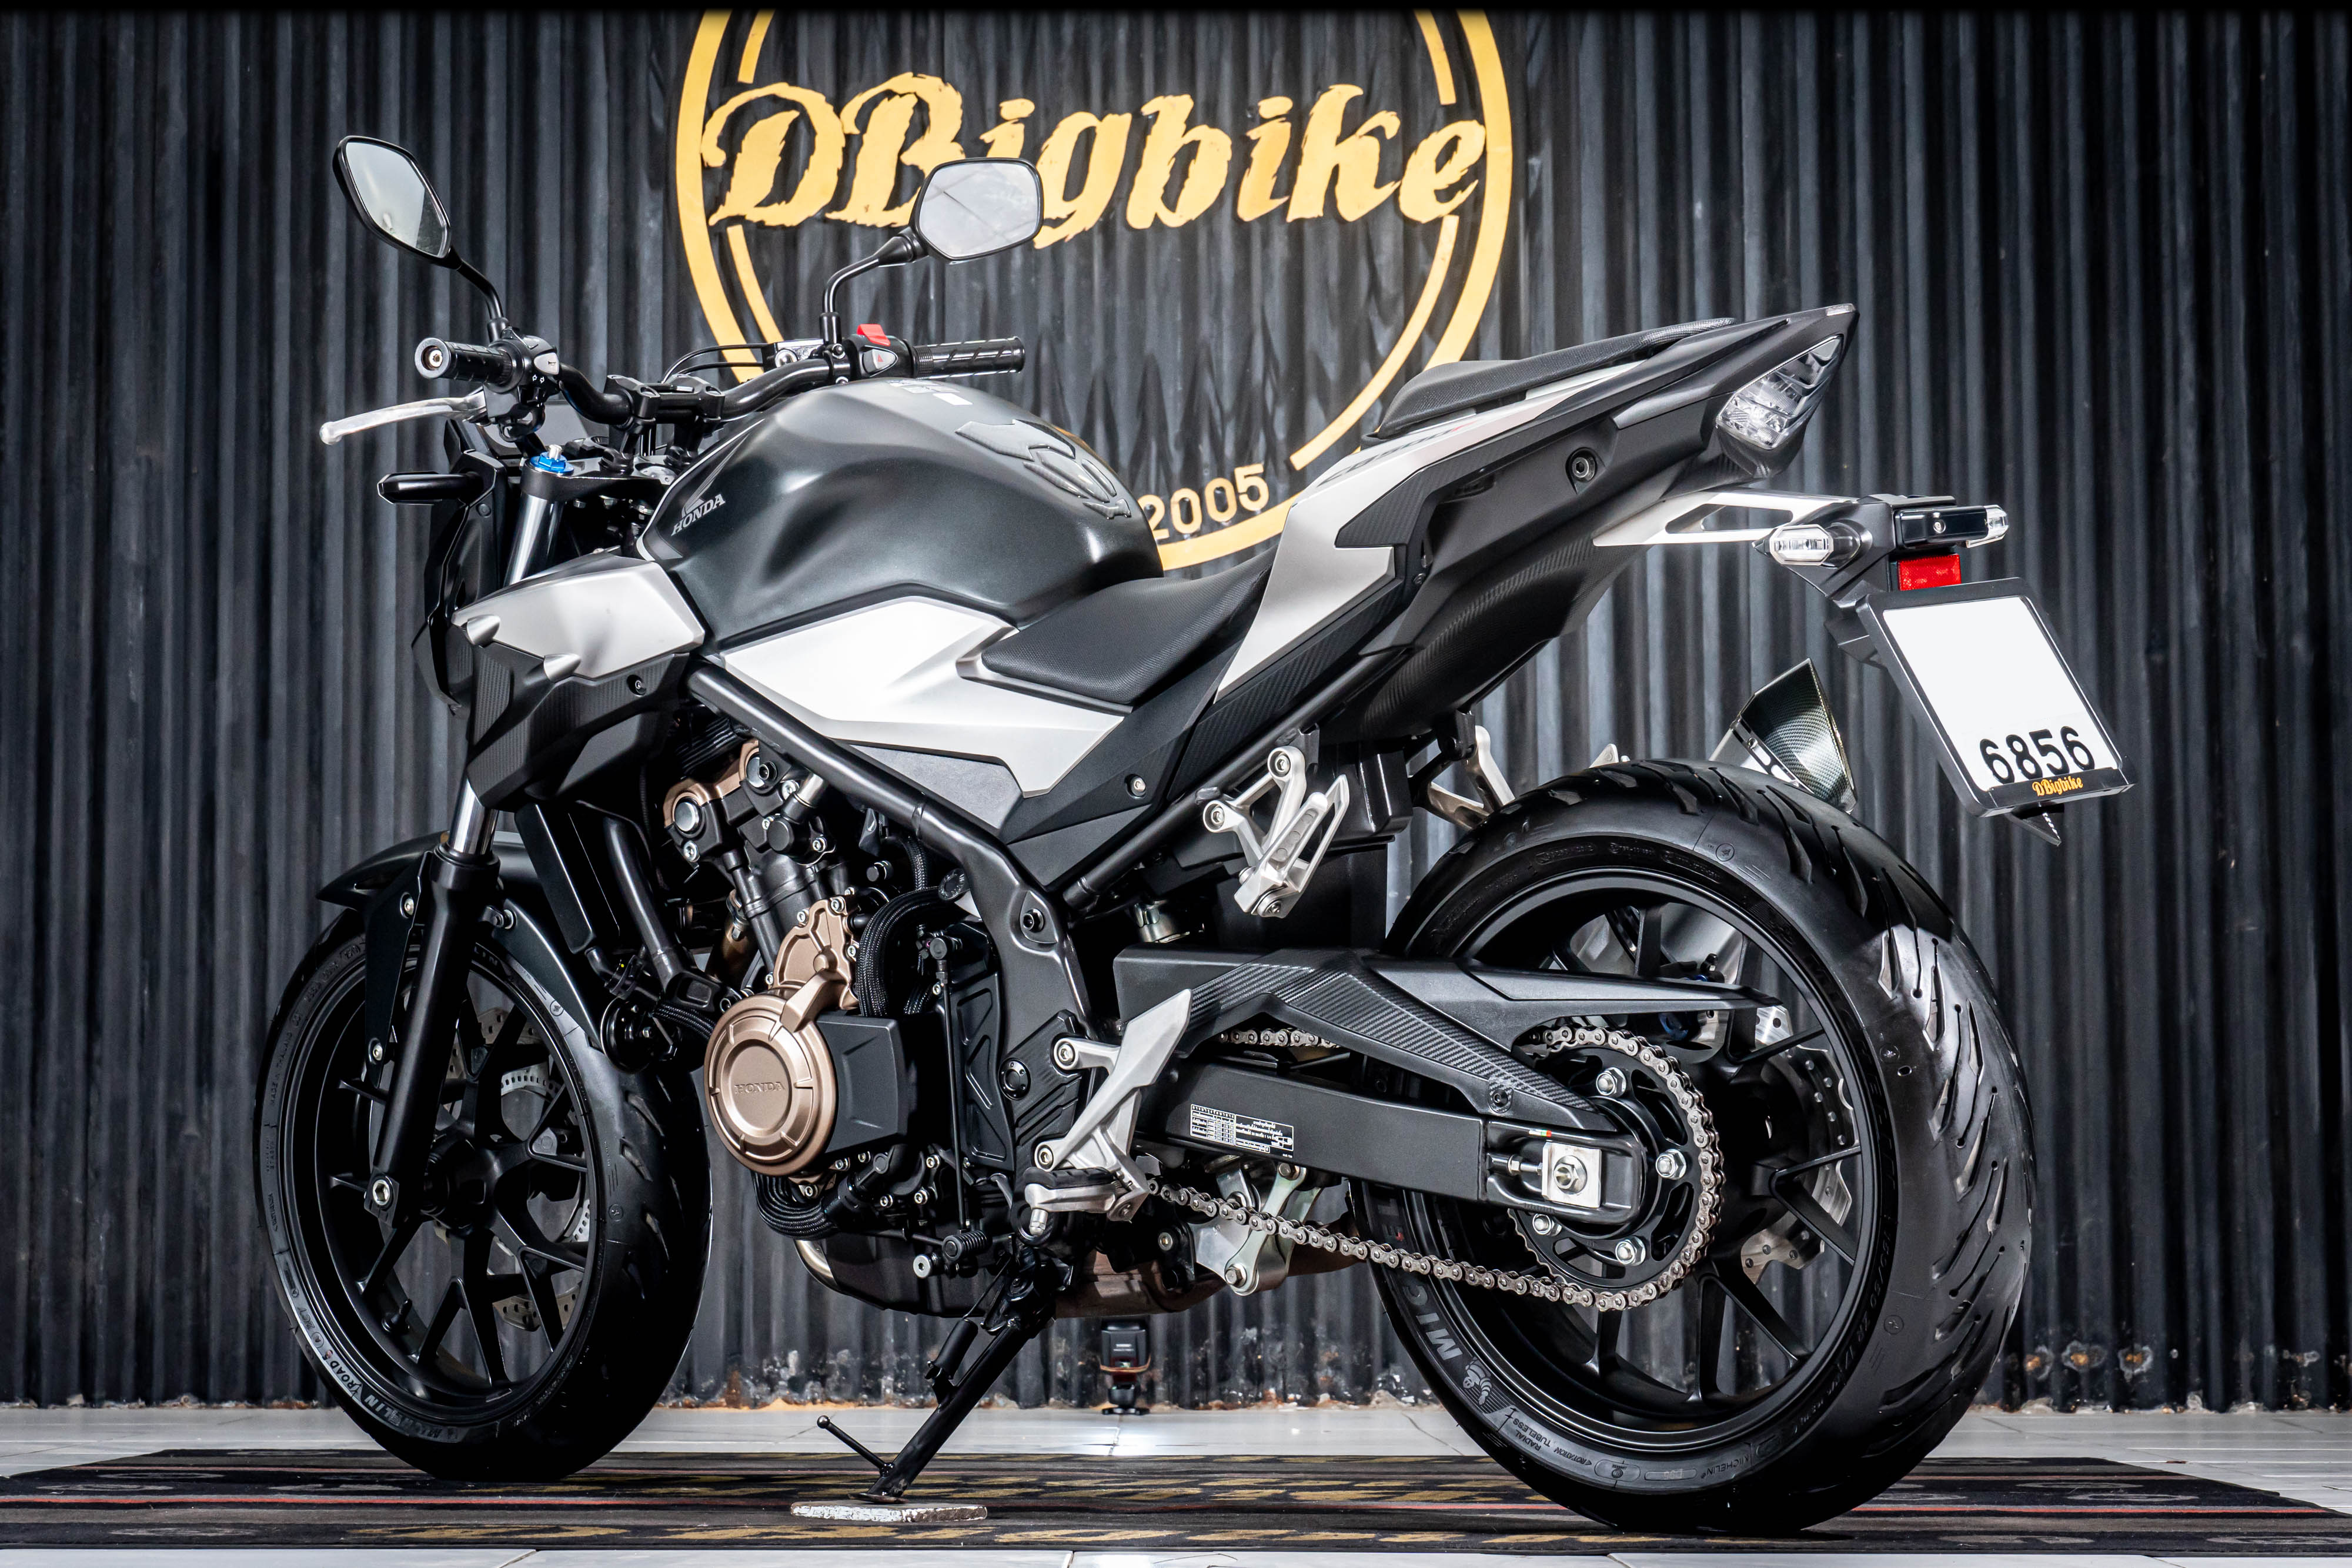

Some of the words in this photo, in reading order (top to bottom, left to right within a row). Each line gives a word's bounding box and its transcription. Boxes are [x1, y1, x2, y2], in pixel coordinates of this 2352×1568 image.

[671, 494, 726, 537] HONDA
[1137, 463, 1269, 540] 2005
[1979, 726, 2095, 785] 6856
[2032, 775, 2083, 797] DBigbike
[734, 1081, 786, 1095] HONDA
[330, 1360, 355, 1390] ROAD
[1512, 1417, 1552, 1447] TUBELESS
[1515, 1429, 1542, 1452] RADIAL
[1553, 1446, 1588, 1466] ROTATION
